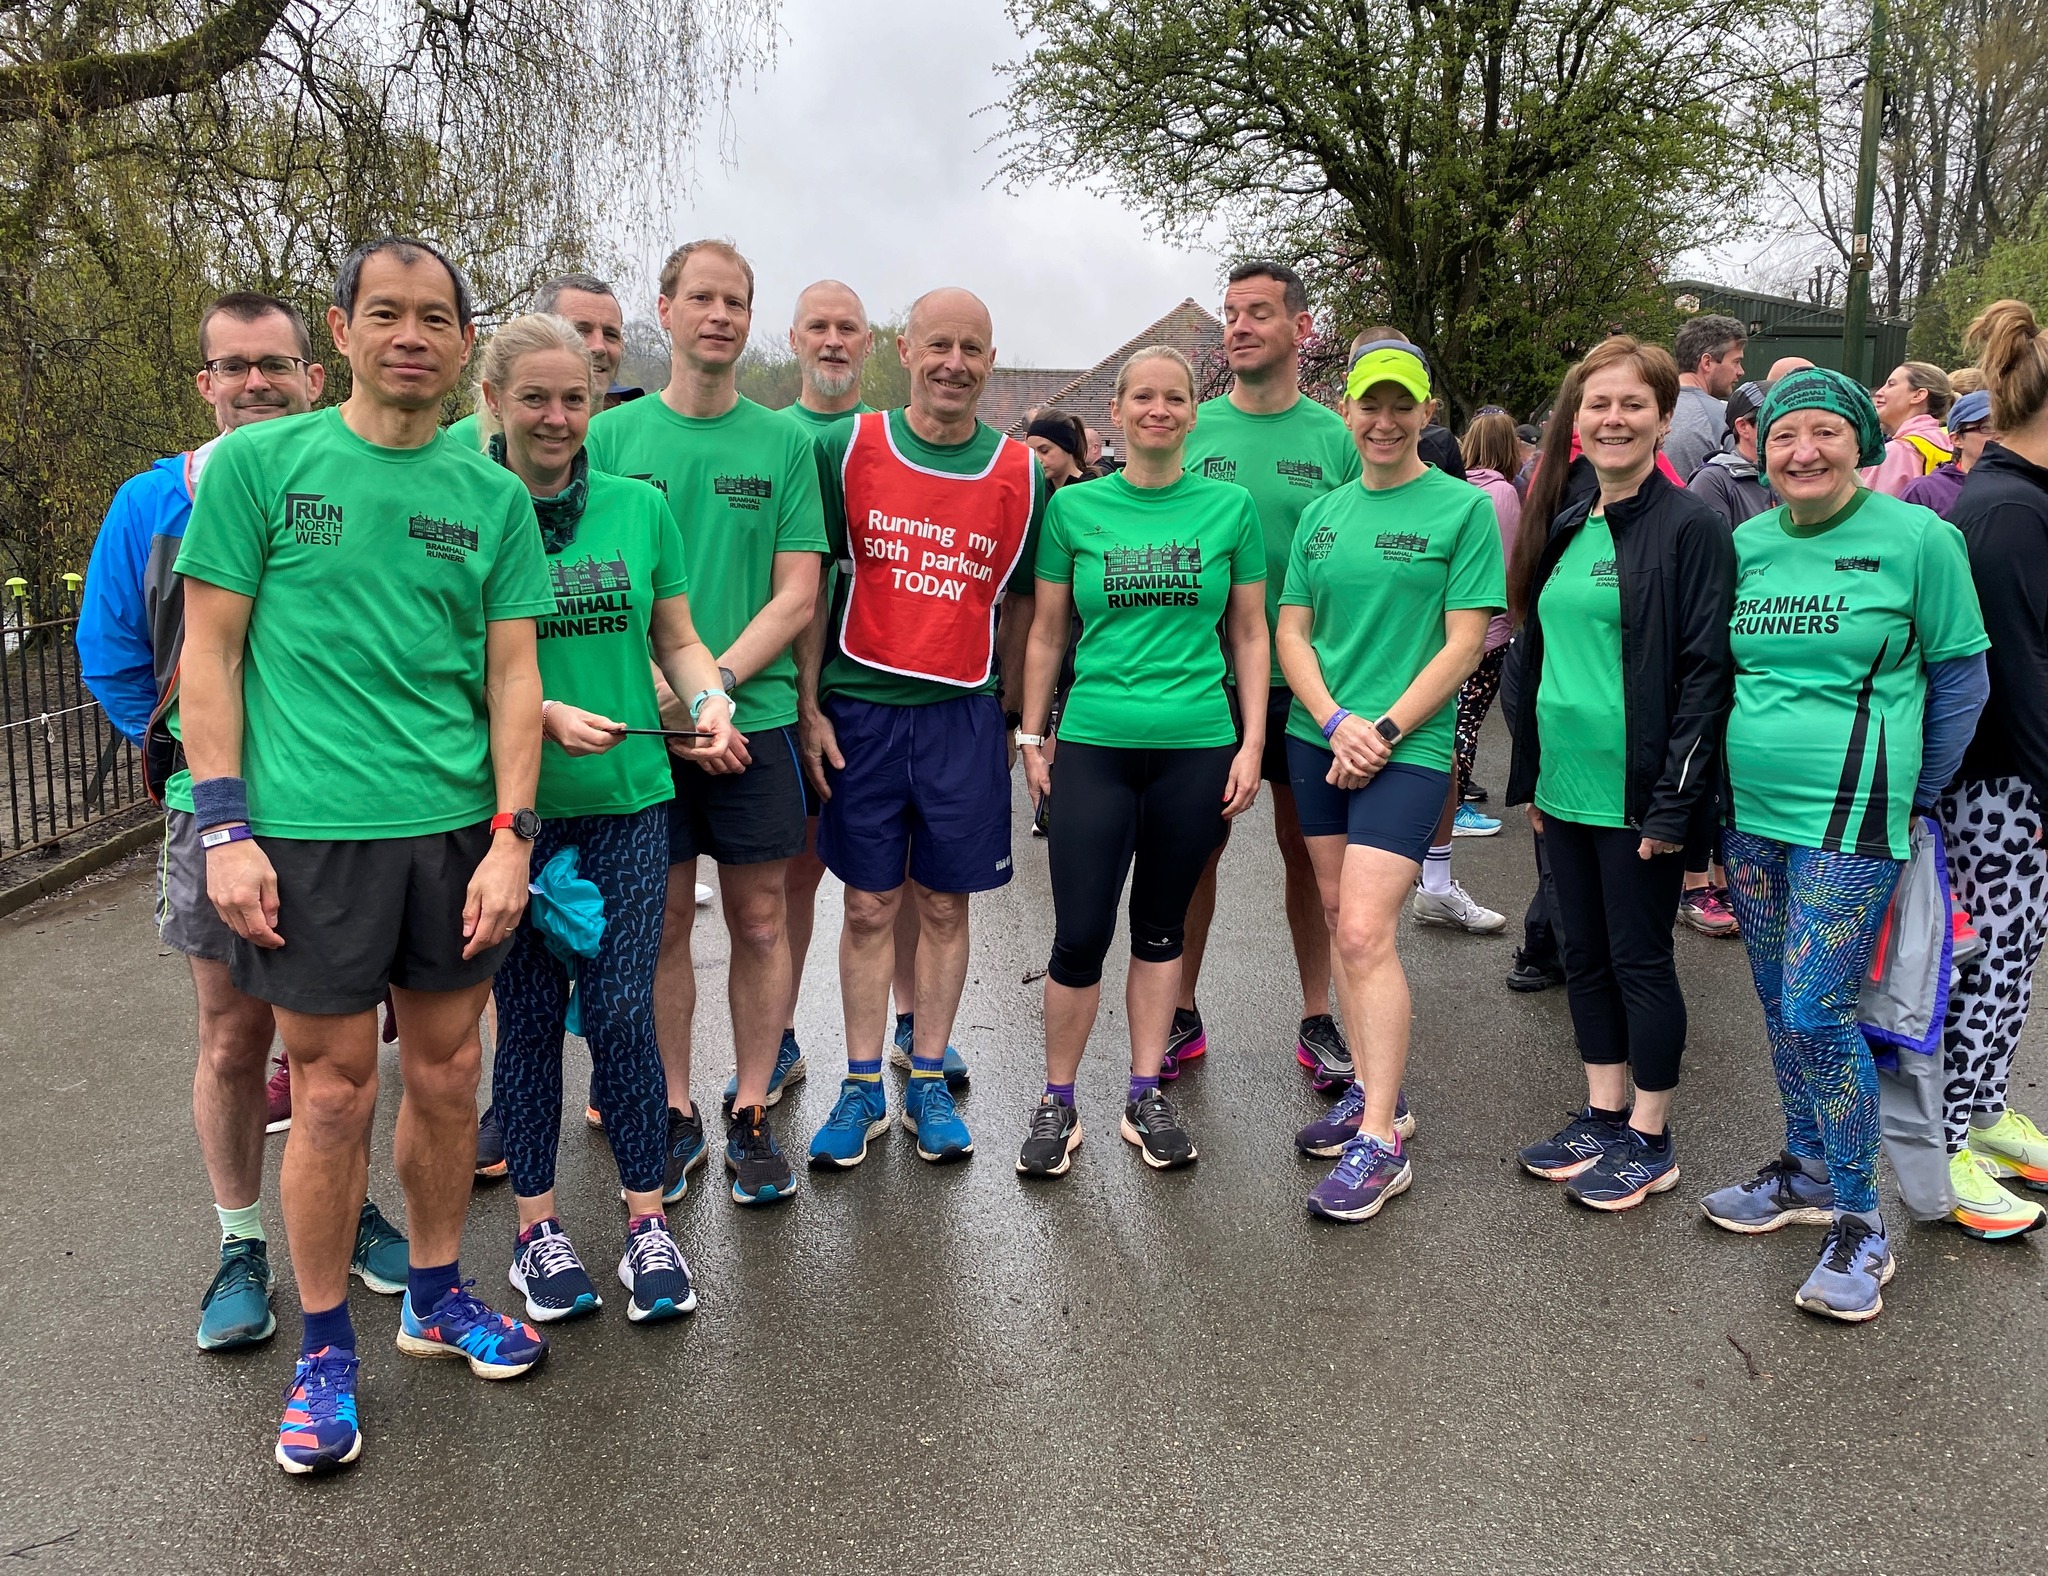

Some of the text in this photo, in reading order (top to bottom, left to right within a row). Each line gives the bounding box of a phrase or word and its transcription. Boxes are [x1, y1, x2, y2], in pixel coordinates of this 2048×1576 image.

[1209, 460, 1237, 474] RUN
[1208, 472, 1236, 480] NORTH
[728, 496, 761, 505] BRAMHALL
[729, 502, 760, 511] RUNNERS
[296, 502, 343, 523] RUN
[295, 519, 343, 534] NORTH
[868, 509, 998, 559] Running my
[295, 531, 342, 547] WEST
[1312, 532, 1338, 543] RUN
[425, 542, 468, 557] BRAMHALL
[426, 550, 465, 564] RUNNERS
[1383, 550, 1413, 558] BRAMHALL
[863, 537, 993, 583] 50th parkrun
[891, 567, 967, 602] TODAY
[1103, 574, 1203, 593] BRAMHALL
[551, 593, 633, 616] MHALL
[1107, 592, 1199, 609] RUNNERS
[1736, 594, 1850, 617] BRAMHALL
[536, 614, 629, 640] UNNERS
[1734, 614, 1840, 635] RUNNERS
